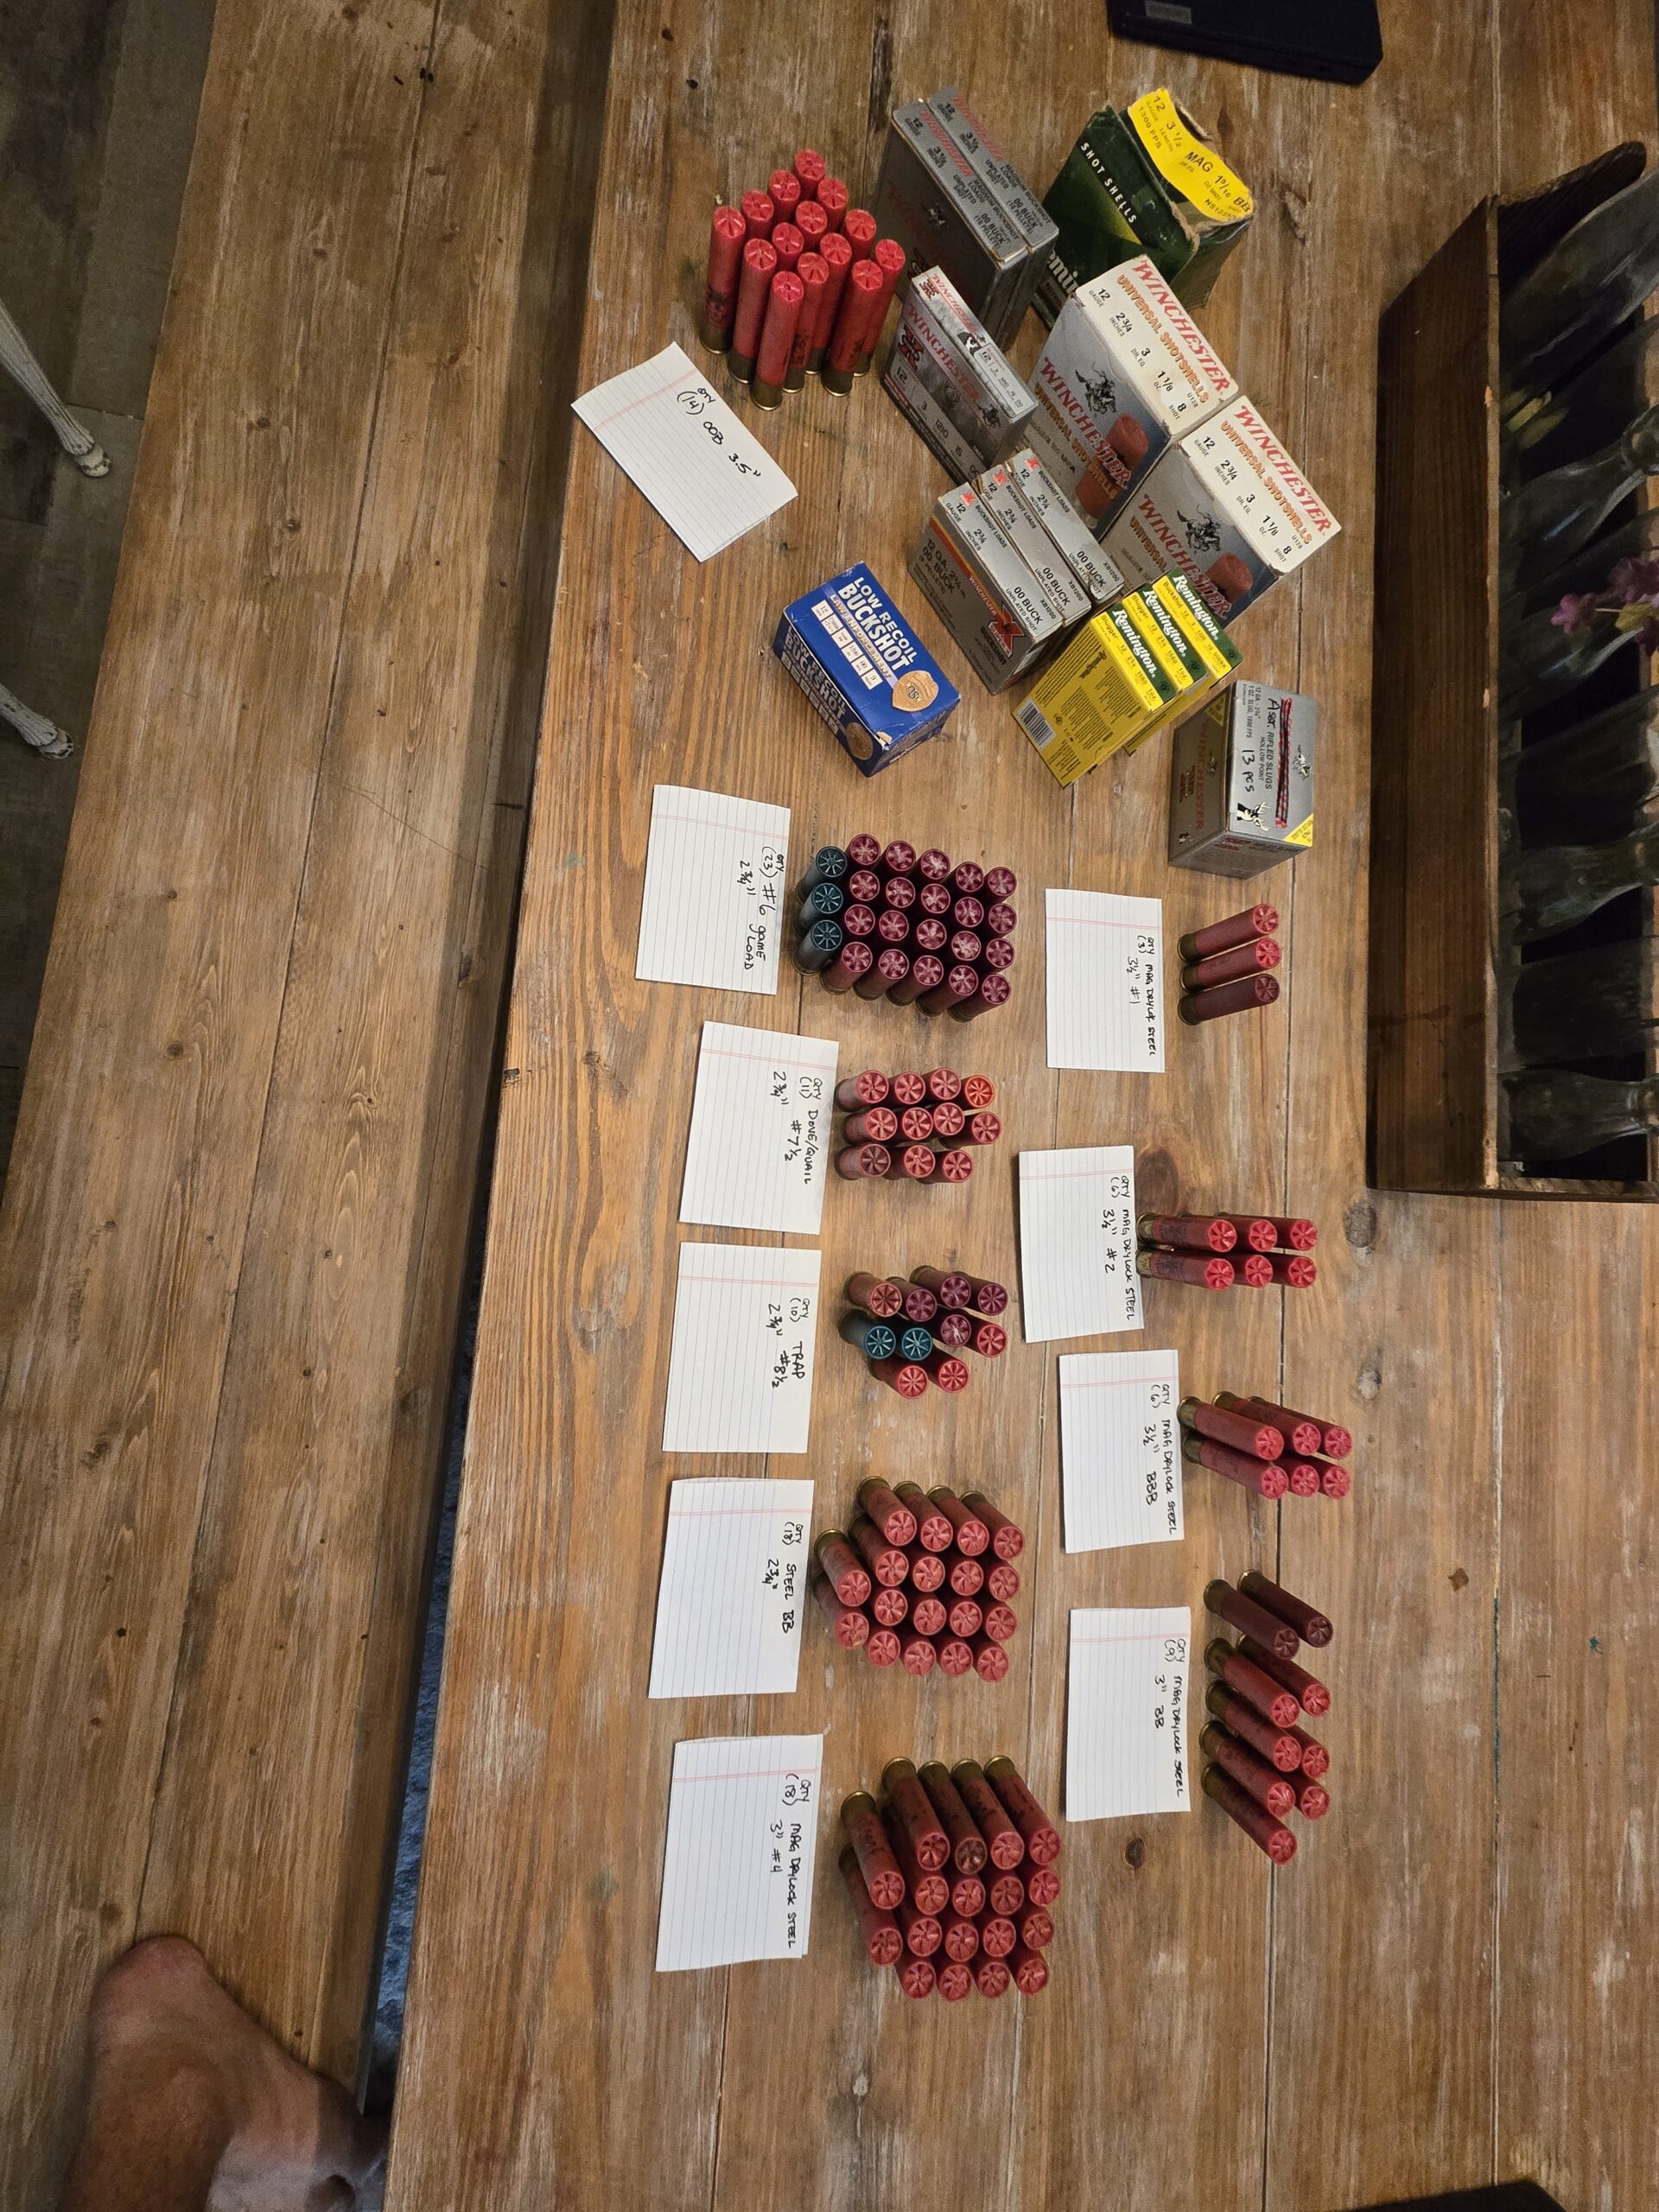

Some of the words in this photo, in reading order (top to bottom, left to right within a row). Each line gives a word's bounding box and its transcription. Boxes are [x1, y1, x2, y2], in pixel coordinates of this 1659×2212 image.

[1149, 127, 1162, 149] FPS
[1152, 95, 1166, 113] 12
[1184, 149, 1214, 173] MAG
[1079, 142, 1105, 175] SHOT
[1103, 177, 1137, 224] SHELLS
[1115, 273, 1163, 334] UNIVERSAL
[1158, 331, 1211, 404] SHOTSHELLS
[1131, 257, 1232, 395] WINCHESTER
[905, 306, 982, 404] WINCHESTER
[1096, 287, 1110, 302] 12
[1176, 402, 1187, 412] 8
[674, 386, 708, 419] (14)
[696, 385, 715, 404] QTY
[1034, 356, 1135, 489] WINCHESTER
[1193, 438, 1209, 457] GAUGE
[1213, 465, 1230, 486] INCHES
[1232, 404, 1332, 534] WINCHESTER
[1004, 484, 1026, 511] BUCKSHOT
[1037, 469, 1058, 497] BUCKSHOT
[1055, 495, 1071, 513] LOADS
[1201, 435, 1216, 449] 12
[1282, 544, 1292, 555] 8
[1218, 419, 1268, 479] UNIVERSAL
[1262, 475, 1313, 544] SHOTSHELLS
[974, 504, 995, 531] BUCKSHOT
[993, 531, 1007, 548] LOADS
[1019, 467, 1030, 480] 12
[1084, 561, 1107, 588] BUCK
[944, 502, 961, 523] GAUGE
[964, 529, 982, 551] INCHES
[1005, 588, 1027, 617] UNPLATED
[1024, 615, 1037, 632] SHOT
[955, 502, 966, 514] 12
[1020, 597, 1043, 625] BUCK
[1134, 493, 1234, 619] WINCHESTER
[931, 562, 957, 594] BUCK
[1049, 578, 1071, 606] BUCK
[968, 575, 998, 616] WINCHESTER
[837, 581, 910, 674] BUCKSHOT
[854, 575, 883, 611] LOW
[878, 610, 919, 663] RECOIL
[829, 593, 847, 615] LAW
[843, 613, 893, 680] ENFORCEMENT
[780, 633, 845, 718] BUCKSHOT
[810, 662, 849, 713] RECOIL
[1242, 748, 1255, 766] 13
[1264, 761, 1273, 789] SLUGS
[759, 846, 778, 877] (23)
[744, 936, 754, 969] LOAD
[1137, 935, 1146, 953] (3)
[798, 1077, 811, 1098] (11)
[812, 1077, 823, 1099] QTY
[804, 1109, 818, 1184] DOVE/QUAIL
[1110, 1177, 1119, 1198] (6)
[1121, 1175, 1129, 1198] QTY
[1122, 1238, 1133, 1281] DRYLOCK
[789, 1297, 800, 1322] (10)
[800, 1298, 810, 1318] QTY
[1125, 1287, 1135, 1320] STEEL
[791, 1341, 804, 1379] TRAP
[1150, 1384, 1160, 1408] (6)
[1160, 1383, 1169, 1404] QTY
[1161, 1420, 1172, 1446] MAG
[1146, 1471, 1156, 1505] BBB
[782, 1522, 795, 1545] (18)
[794, 1523, 803, 1543] QTY
[784, 1563, 796, 1599] STEEL
[782, 1609, 794, 1633] BB
[1164, 1639, 1174, 1662] (9)
[1176, 1638, 1185, 1662] QTY
[1171, 1675, 1182, 1705] MAG
[1154, 1705, 1163, 1728] BB
[1171, 1707, 1181, 1754] DRYLOCK
[782, 1773, 798, 1806] (18)
[799, 1779, 810, 1802] QTY
[1173, 1759, 1183, 1797] STEEL
[788, 1823, 801, 1852] MAG
[787, 1912, 796, 1948] STEEL
